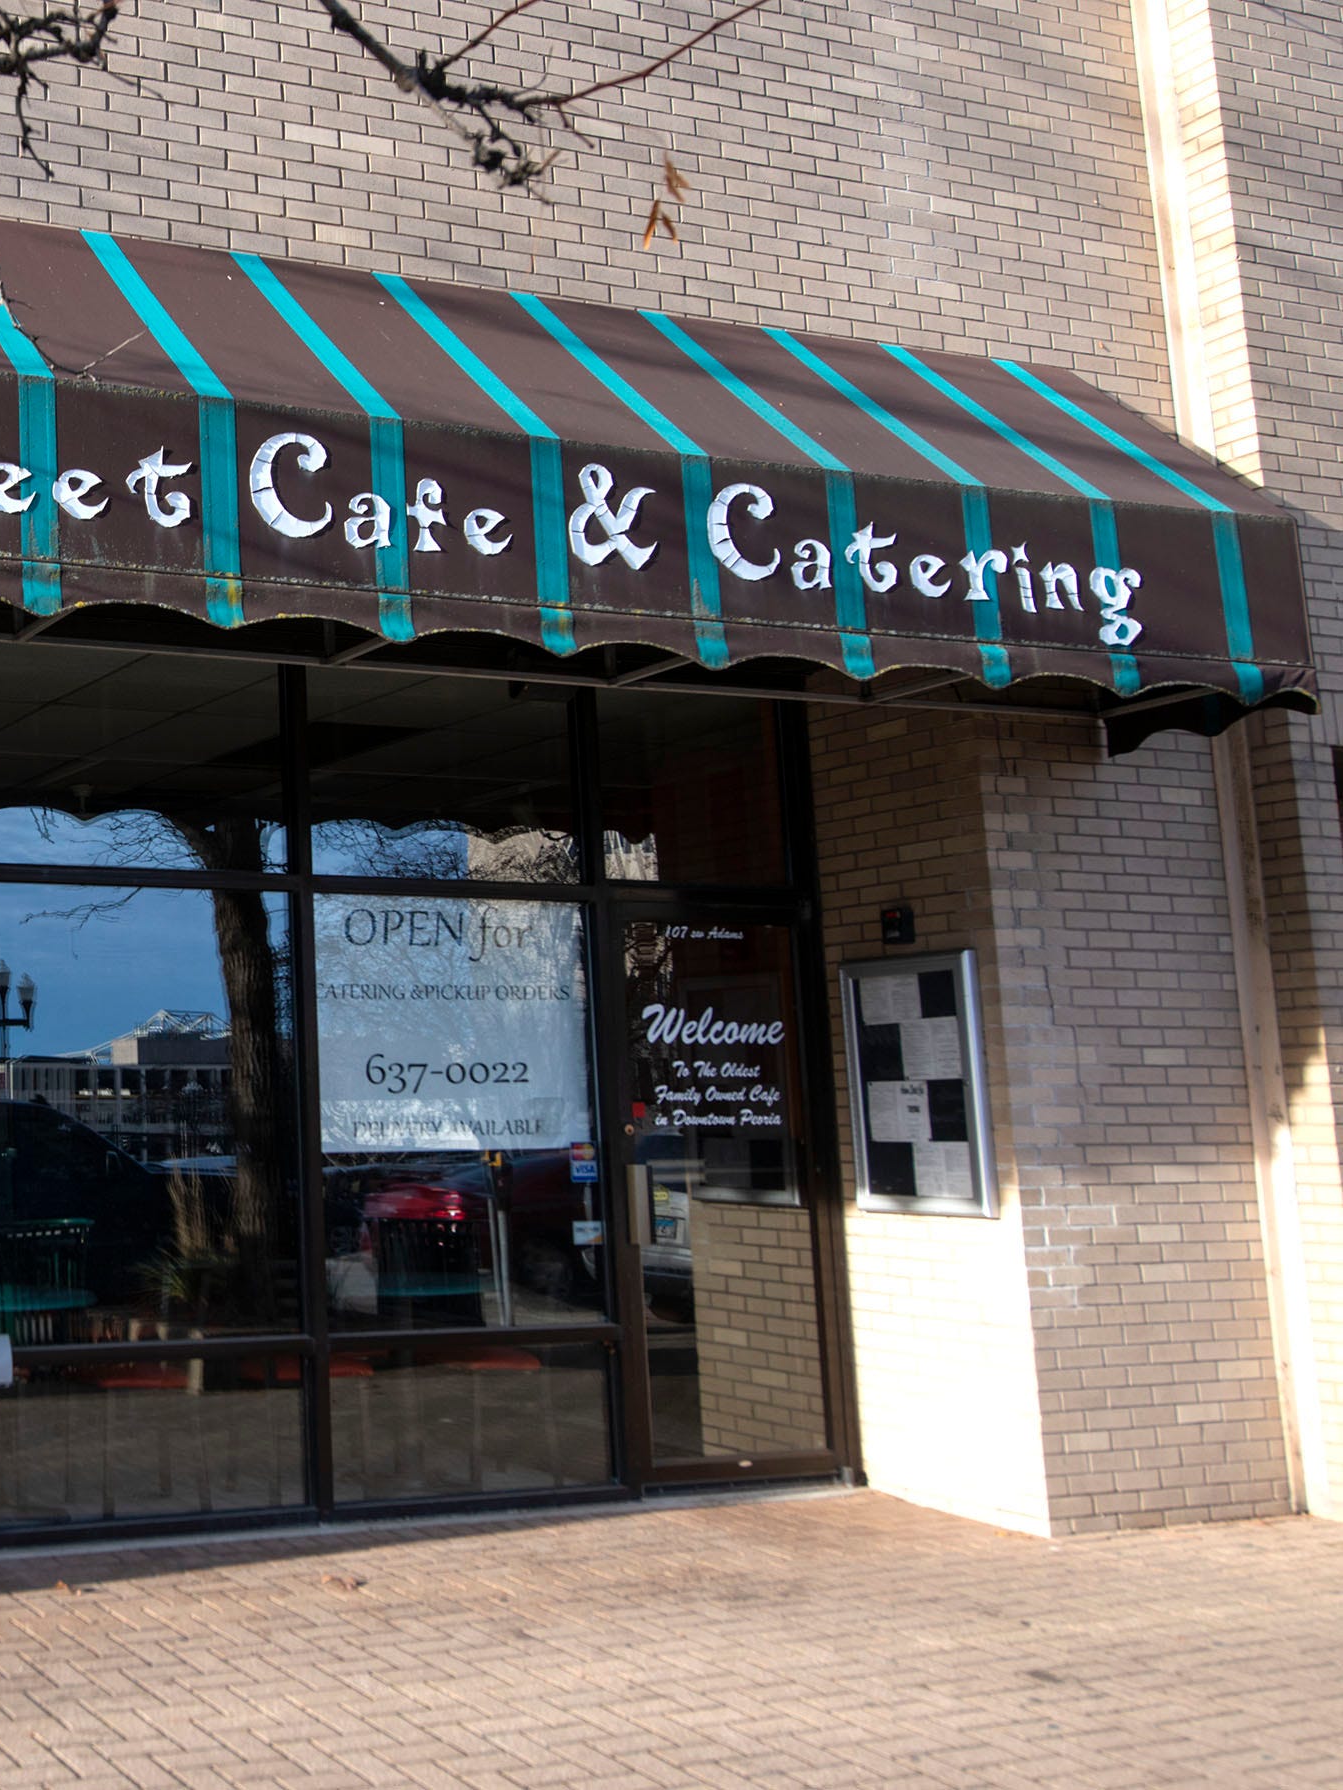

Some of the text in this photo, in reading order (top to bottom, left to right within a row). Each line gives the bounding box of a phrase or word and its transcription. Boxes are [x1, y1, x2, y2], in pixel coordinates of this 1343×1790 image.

[249, 431, 514, 557] Cafe
[568, 462, 658, 571] &
[707, 482, 1143, 647] Catering
[344, 905, 533, 962] OPEN for
[664, 925, 689, 939] 107
[707, 926, 744, 940] Adams
[495, 982, 571, 1001] ORDERS
[642, 1003, 785, 1045] Welcome
[364, 1053, 530, 1095] 637-0022
[672, 1061, 761, 1078] To The Oldest
[654, 1085, 781, 1107] Family Owned Cafe
[655, 1108, 783, 1126] in Downtown Peoria
